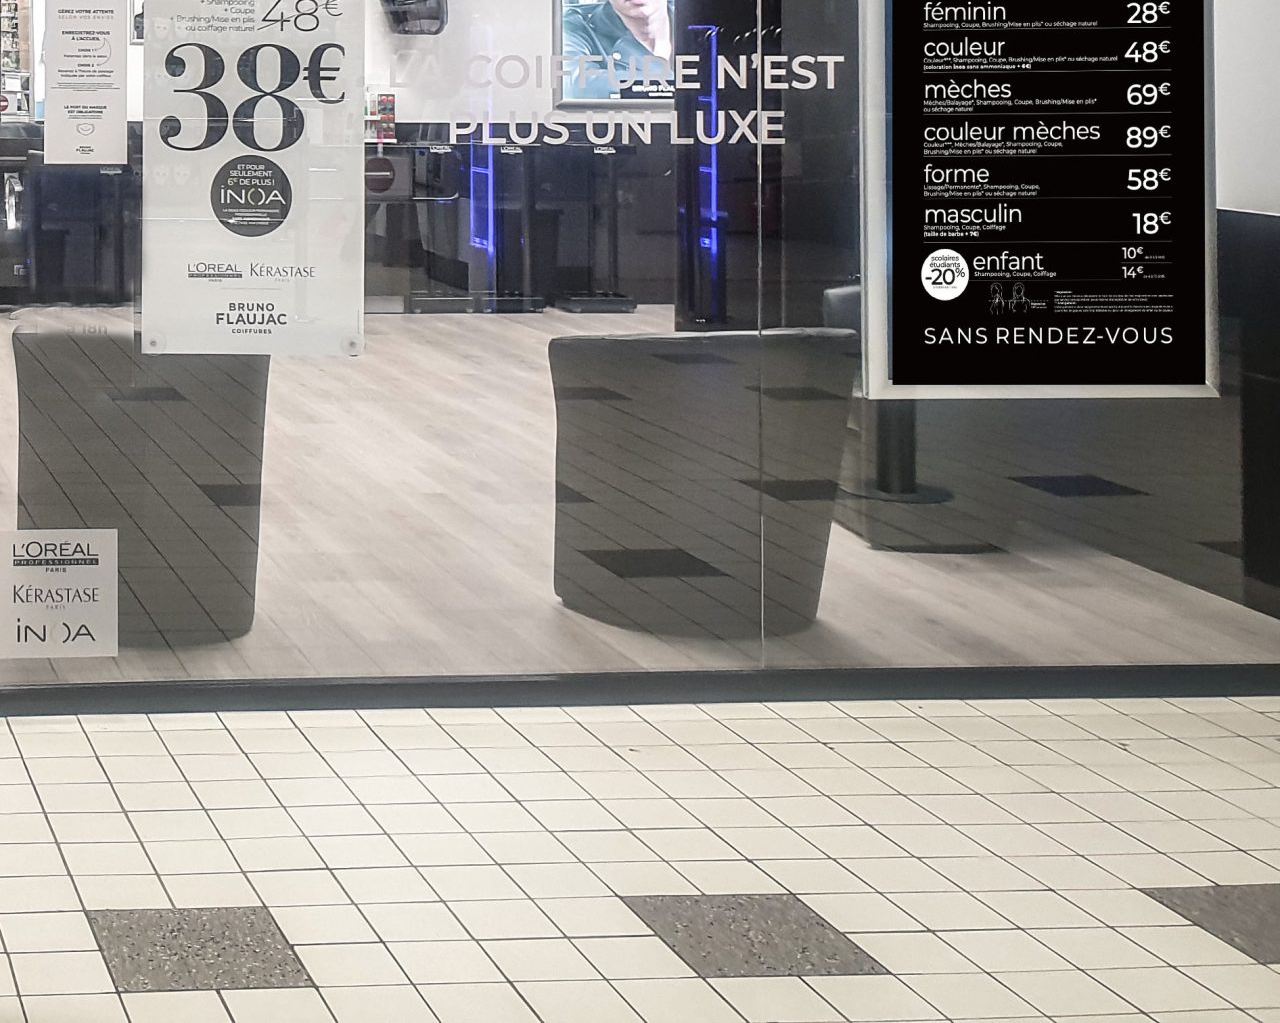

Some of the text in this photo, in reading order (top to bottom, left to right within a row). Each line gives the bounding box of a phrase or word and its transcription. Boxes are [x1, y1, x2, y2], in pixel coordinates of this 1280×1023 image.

[924, 1, 1006, 21] féminin
[1126, 1, 1171, 24] 28€
[924, 37, 1006, 56] couleur
[1124, 40, 1171, 63] 48€
[467, 54, 700, 90] COIFFURE
[718, 54, 845, 90] N'EST
[159, 42, 346, 151] 38€
[925, 79, 1012, 98] mèches
[1127, 82, 1171, 105] 69€
[449, 110, 786, 145] PLUS UN LUXE
[924, 120, 1101, 141] couleur mèches
[1126, 125, 1171, 148] 89€
[924, 164, 989, 183] forme
[1127, 167, 1171, 190] 58€
[925, 203, 1022, 223] masculin
[1132, 211, 1171, 234] 18€
[973, 251, 1044, 270] enfant
[1122, 247, 1143, 259] 10€
[249, 263, 315, 278] KÉRASTASE
[925, 268, 965, 285] -20%
[1122, 266, 1143, 278] 14€
[229, 302, 275, 312] BRUNO
[216, 313, 287, 325] FLAUJAC
[924, 327, 1173, 344] SANS RENDEZ-VOUS
[13, 541, 99, 558] L'ORÉAL
[13, 584, 99, 603] KÉRASTASE
